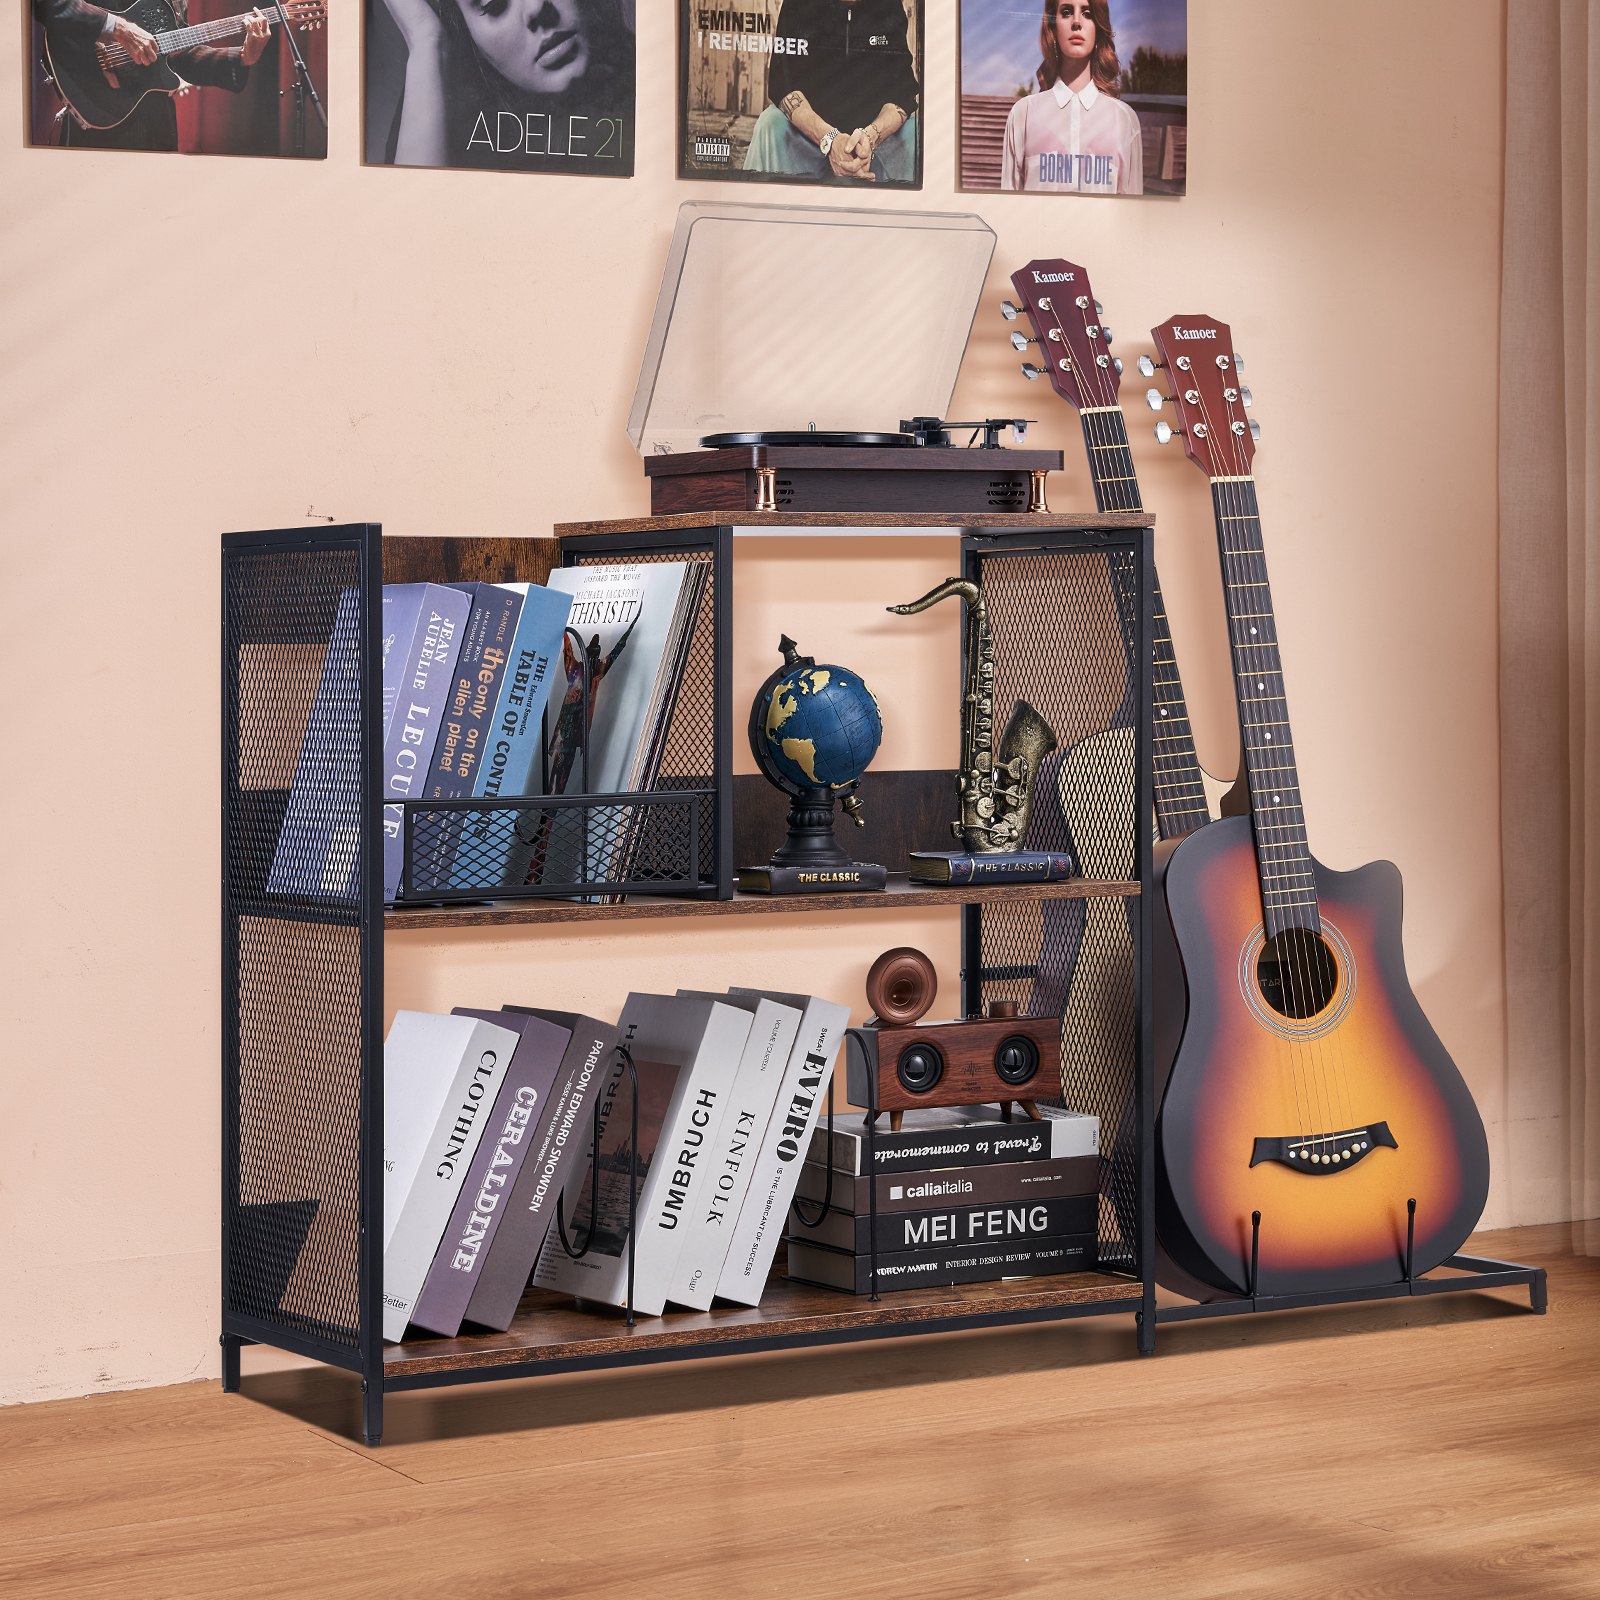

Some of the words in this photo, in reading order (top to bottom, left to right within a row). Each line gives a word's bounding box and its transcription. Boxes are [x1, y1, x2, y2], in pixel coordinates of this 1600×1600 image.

[697, 9, 771, 34] EMINEM
[697, 31, 703, 49] I
[709, 32, 809, 56] REMEMBER
[466, 110, 588, 157] ADELE
[594, 118, 623, 159] 21
[696, 143, 729, 156] ADVISORY
[1040, 153, 1072, 183] BORN
[1075, 154, 1092, 191] TO
[1094, 155, 1113, 185] DIE
[1031, 270, 1075, 283] Kamoer
[1172, 326, 1216, 340] Kamoer
[575, 589, 604, 600] MICHAEL
[474, 607, 483, 620] FOR
[570, 601, 604, 625] THIS
[602, 600, 618, 623] IS
[617, 600, 637, 623] IT
[469, 620, 478, 641] YOUNG
[478, 630, 486, 645] BEST
[495, 609, 511, 643] RANDLE
[412, 610, 443, 690] AURELIE
[433, 617, 456, 665] JEAN
[463, 640, 473, 663] ADULTS
[472, 645, 482, 662] BOOK
[479, 646, 506, 684] the
[533, 656, 549, 683] THE
[508, 650, 536, 707] TABLE
[452, 678, 472, 717] alien
[467, 684, 490, 720] only
[527, 684, 538, 708] Edward
[501, 711, 519, 738] OF
[518, 708, 531, 736] Snowden
[439, 722, 462, 773] planet
[465, 728, 479, 750] on
[457, 751, 478, 778] the
[798, 872, 819, 884] THE
[819, 871, 860, 884] CLASSIC
[977, 863, 998, 873] THE
[1000, 860, 1045, 872] CLASSIC
[816, 1027, 828, 1052] SWEAT
[576, 1039, 604, 1092] PARDON
[561, 1081, 572, 1097] JESSE
[436, 1050, 497, 1182] CLOTHING
[776, 1051, 828, 1162] EVERO
[546, 1121, 557, 1137] LUKE
[555, 1092, 584, 1147] EDWARD
[874, 1143, 970, 1163] commemorate
[976, 1142, 989, 1154] to
[994, 1135, 1042, 1155] Travel
[658, 1088, 717, 1230] UMBRUCH
[706, 1110, 756, 1226] KINFOLK
[776, 1167, 784, 1175] IS
[528, 1146, 562, 1213] SNOWDEN
[771, 1176, 781, 1190] THE
[906, 1180, 973, 1198] caliaitalia
[760, 1190, 776, 1232] LUBRICANT
[755, 1231, 763, 1242] OF
[904, 1213, 956, 1245] MEI
[968, 1205, 1048, 1238] FENG
[744, 1242, 759, 1277] SUCCESS
[906, 1262, 938, 1273] MARTIN
[945, 1258, 977, 1269] INTERIOR
[979, 1255, 1004, 1265] DESIGN
[1006, 1252, 1031, 1262] REVIEW
[1035, 1250, 1059, 1259] VOLUME
[383, 1294, 408, 1310] Better
